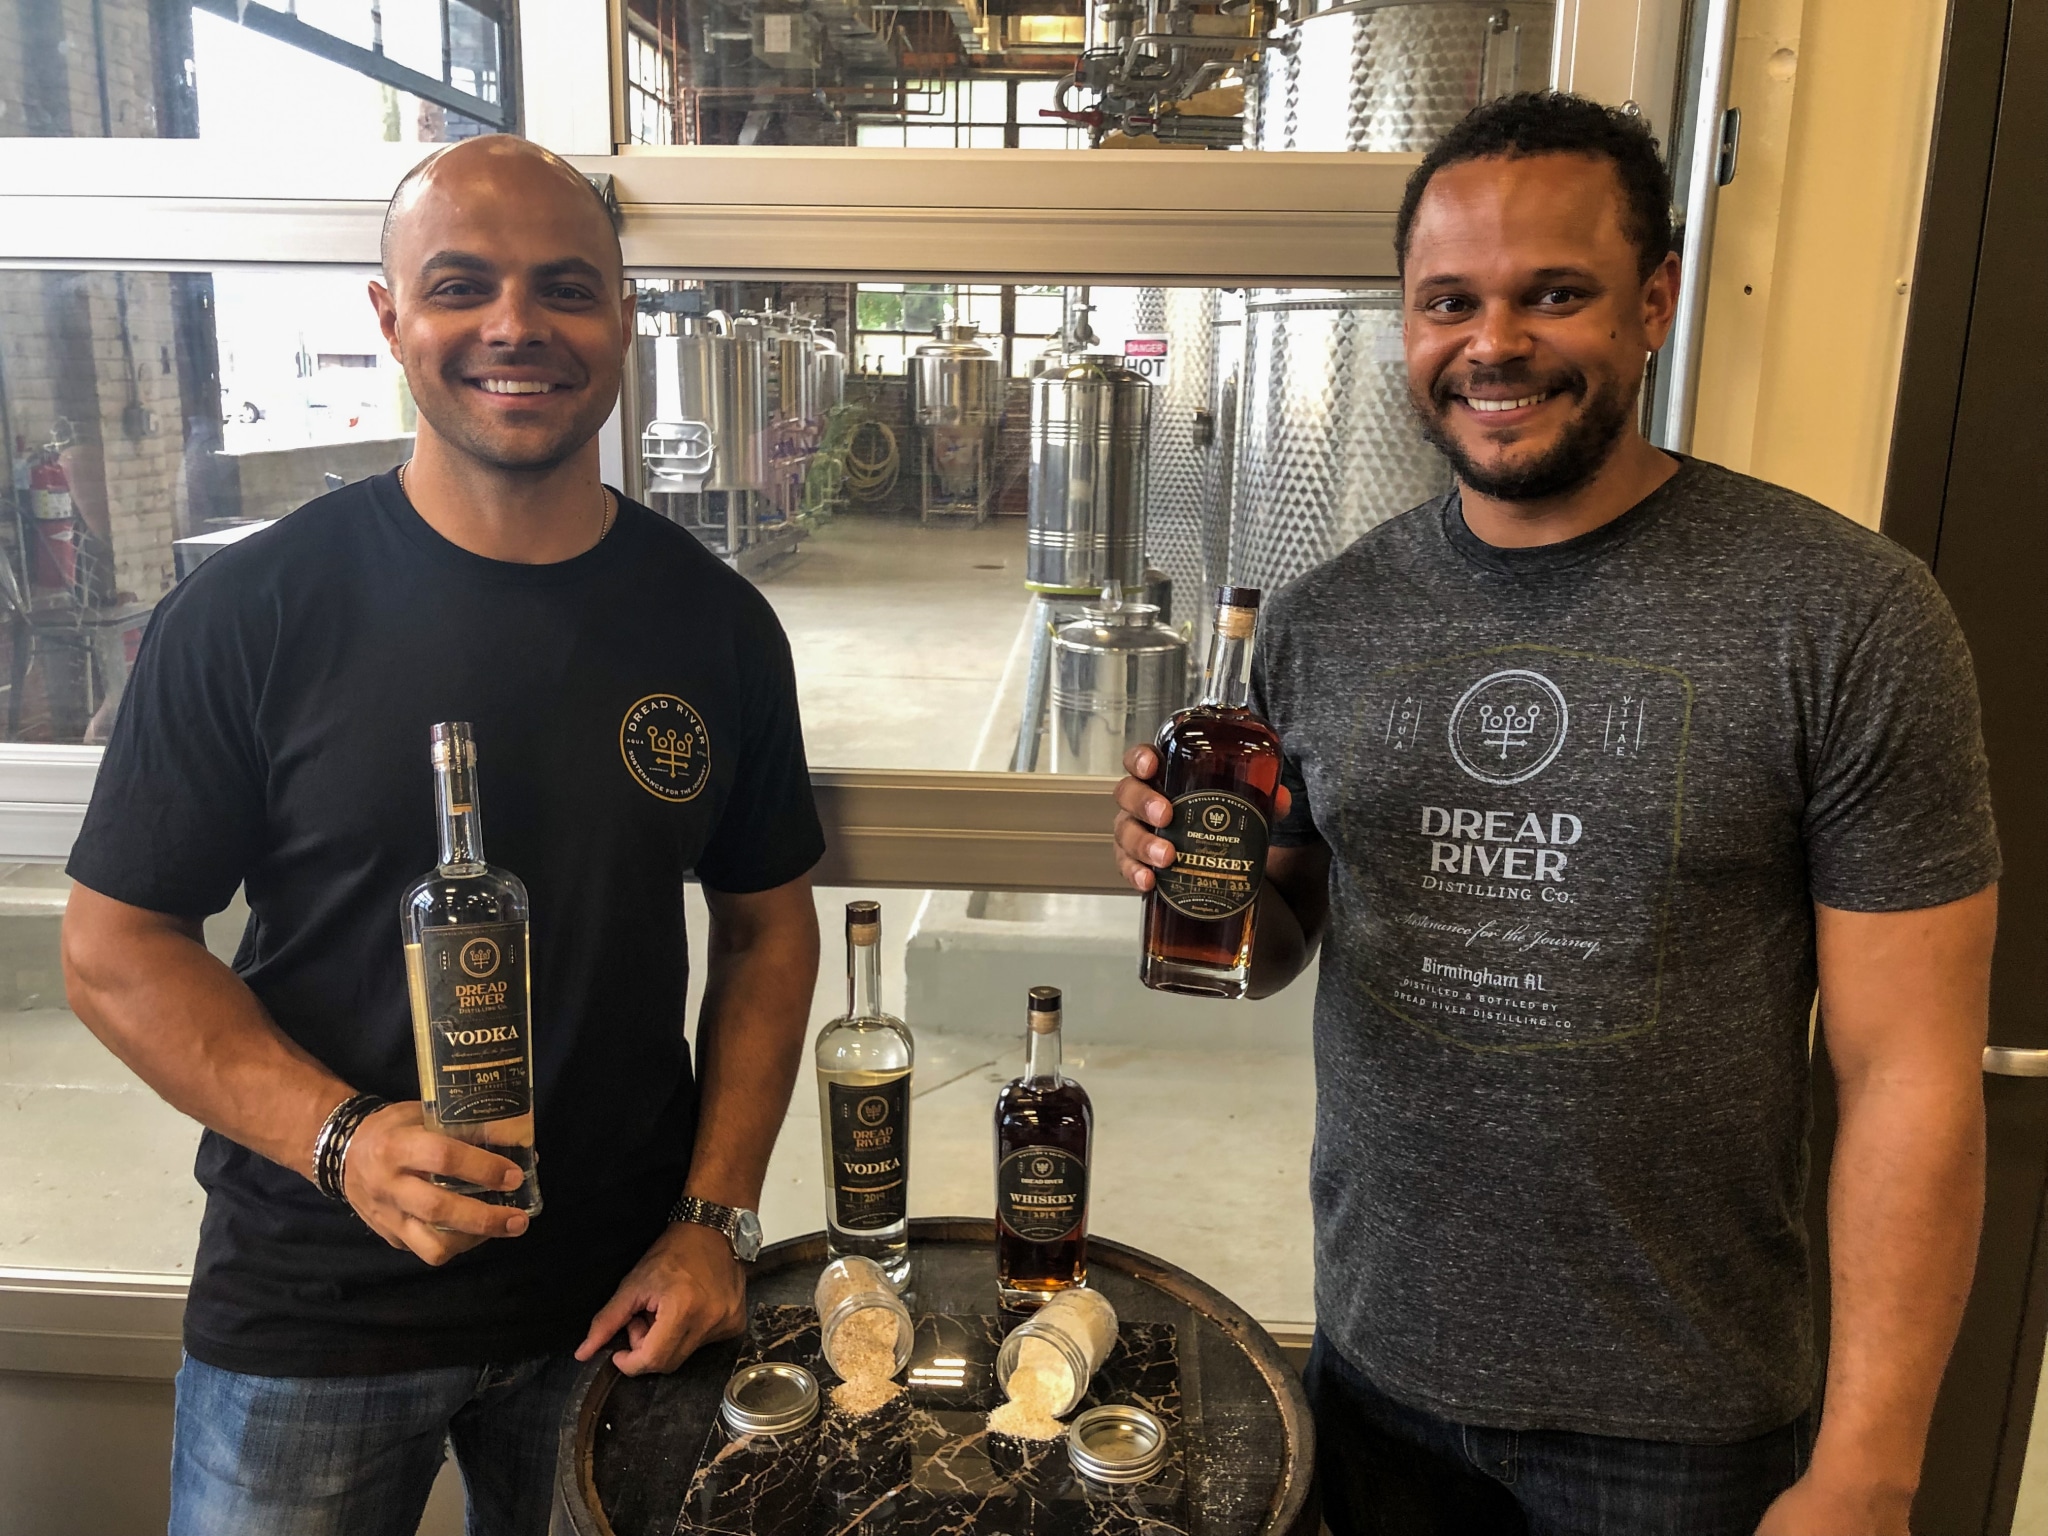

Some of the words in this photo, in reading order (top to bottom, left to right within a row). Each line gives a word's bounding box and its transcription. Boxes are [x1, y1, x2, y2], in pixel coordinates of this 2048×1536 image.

[1127, 343, 1163, 353] DANGER
[1127, 359, 1165, 377] HOT
[628, 700, 669, 732] DREAD
[676, 704, 706, 744] RIVER
[1615, 694, 1633, 757] VITAE
[628, 750, 664, 792] SUSTENANCE
[1420, 805, 1583, 846] DREAD
[1187, 831, 1216, 841] DREAD
[1216, 835, 1241, 844] RIVER
[1430, 840, 1568, 883] RIVER
[1196, 877, 1219, 889] 2019
[1421, 875, 1533, 901] DISTILLING
[1395, 911, 1473, 936] Sustenance
[1464, 919, 1500, 948] for
[1501, 923, 1530, 943] the
[1518, 929, 1601, 961] Journey
[1421, 956, 1519, 988] Birmingham
[1523, 972, 1546, 992] AL
[455, 981, 508, 997] DREAD
[1401, 977, 1460, 999] DISTILLED
[1478, 994, 1536, 1010] BOTTLED
[1542, 1003, 1559, 1013] BY
[460, 993, 505, 1008] RIVER
[1393, 989, 1427, 1007] DREAD
[1431, 1000, 1467, 1016] RIVER
[1473, 1009, 1548, 1027] DISTILLING
[445, 1025, 520, 1047] VODKA
[475, 1070, 500, 1084] 2019
[853, 1126, 894, 1139] DREAD
[856, 1135, 891, 1148] RIVER
[843, 1157, 901, 1175] VODKA
[1009, 1193, 1077, 1204] WHISKEY
